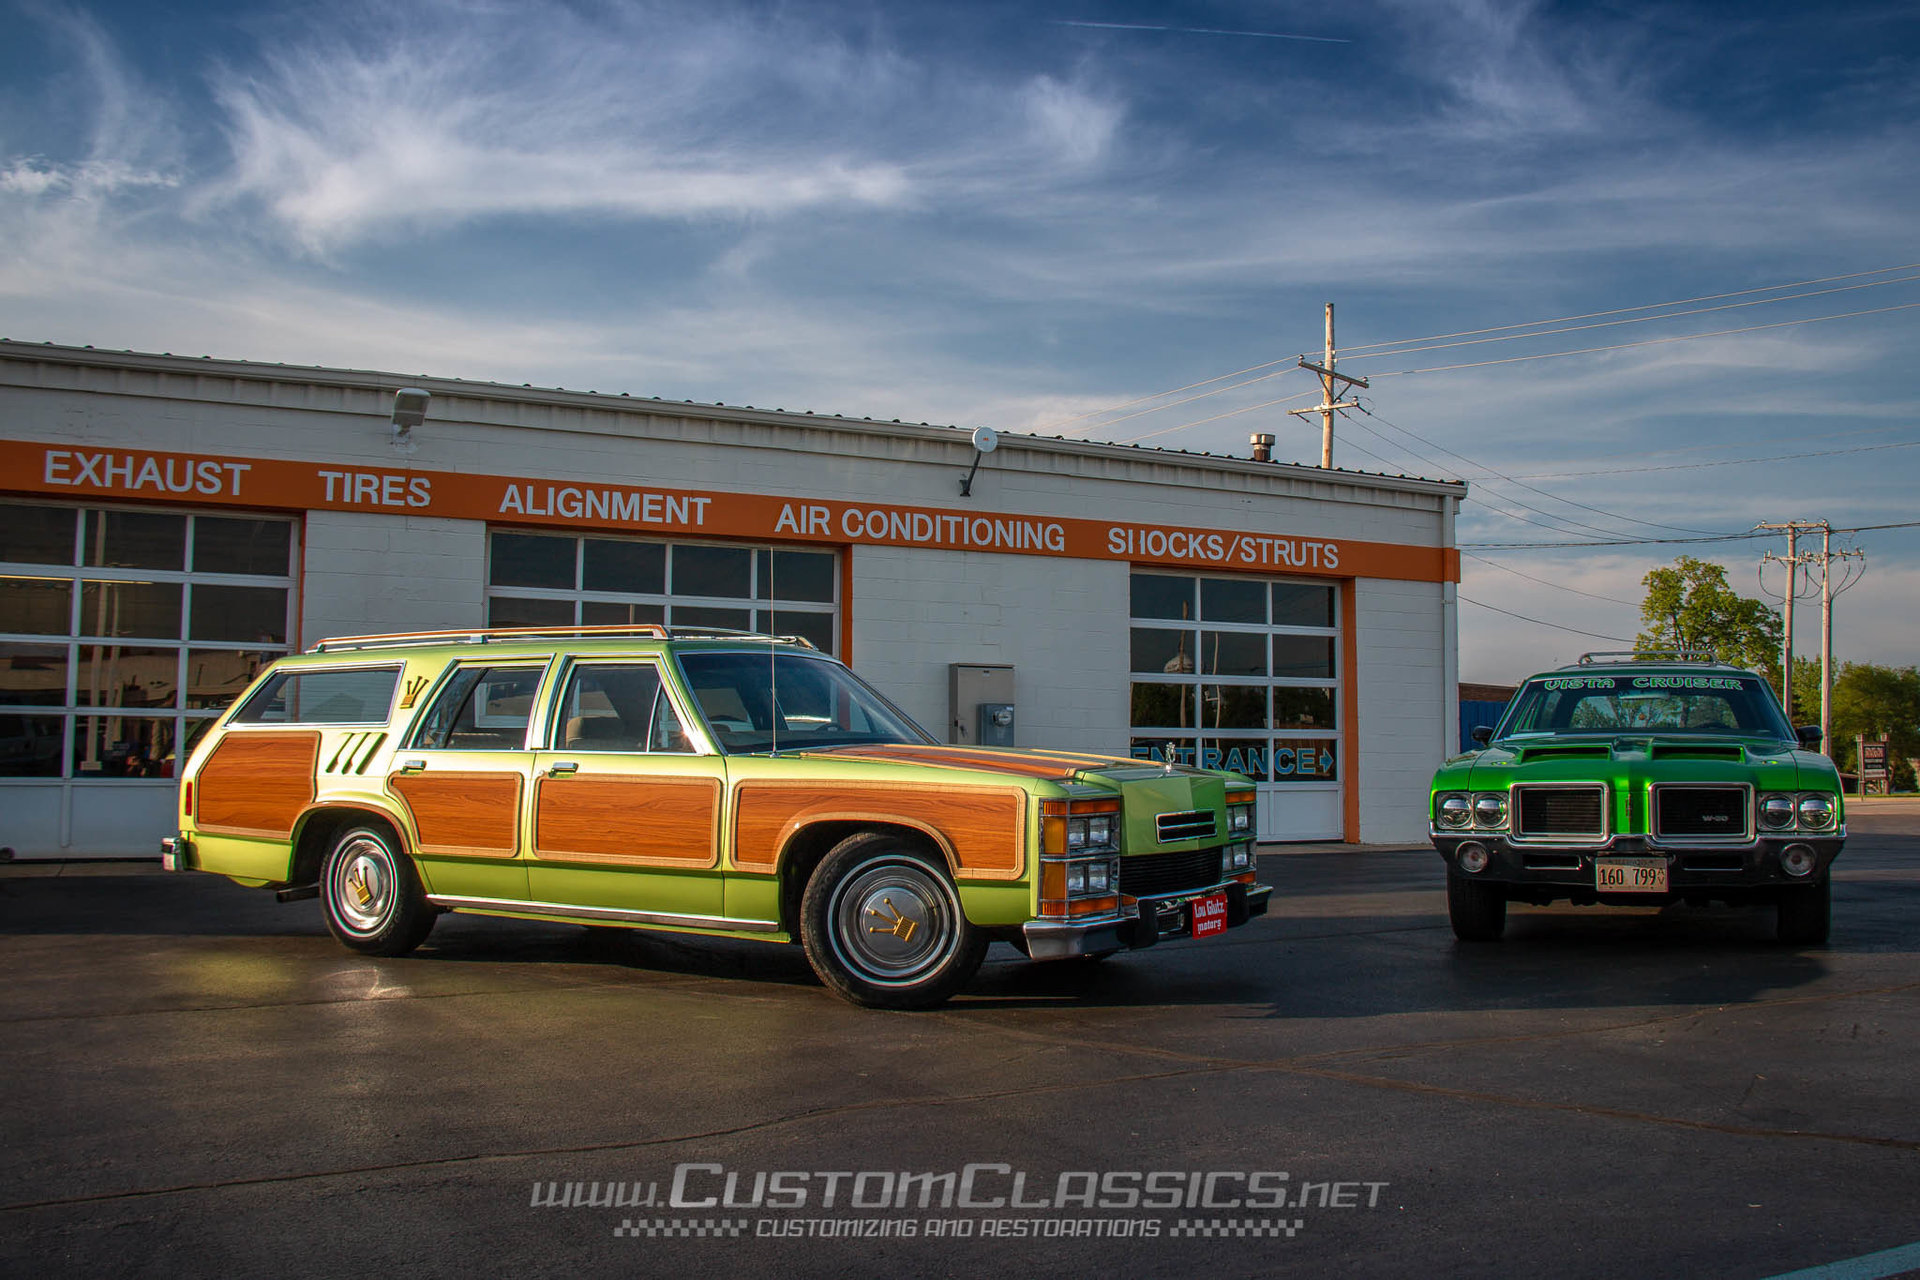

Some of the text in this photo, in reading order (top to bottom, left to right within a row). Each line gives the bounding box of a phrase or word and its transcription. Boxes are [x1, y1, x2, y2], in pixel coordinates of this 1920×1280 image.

[44, 450, 251, 496] EXHAUST
[318, 470, 431, 508] TIRES
[499, 484, 712, 525] ALIGNMENT
[774, 503, 1065, 551] AIR CONDITIONING
[1108, 527, 1339, 569] SHOCKS/STRUTS
[1544, 677, 1743, 691] VISTA CRUISER
[1600, 868, 1656, 885] 160 799
[1194, 903, 1206, 918] Lou
